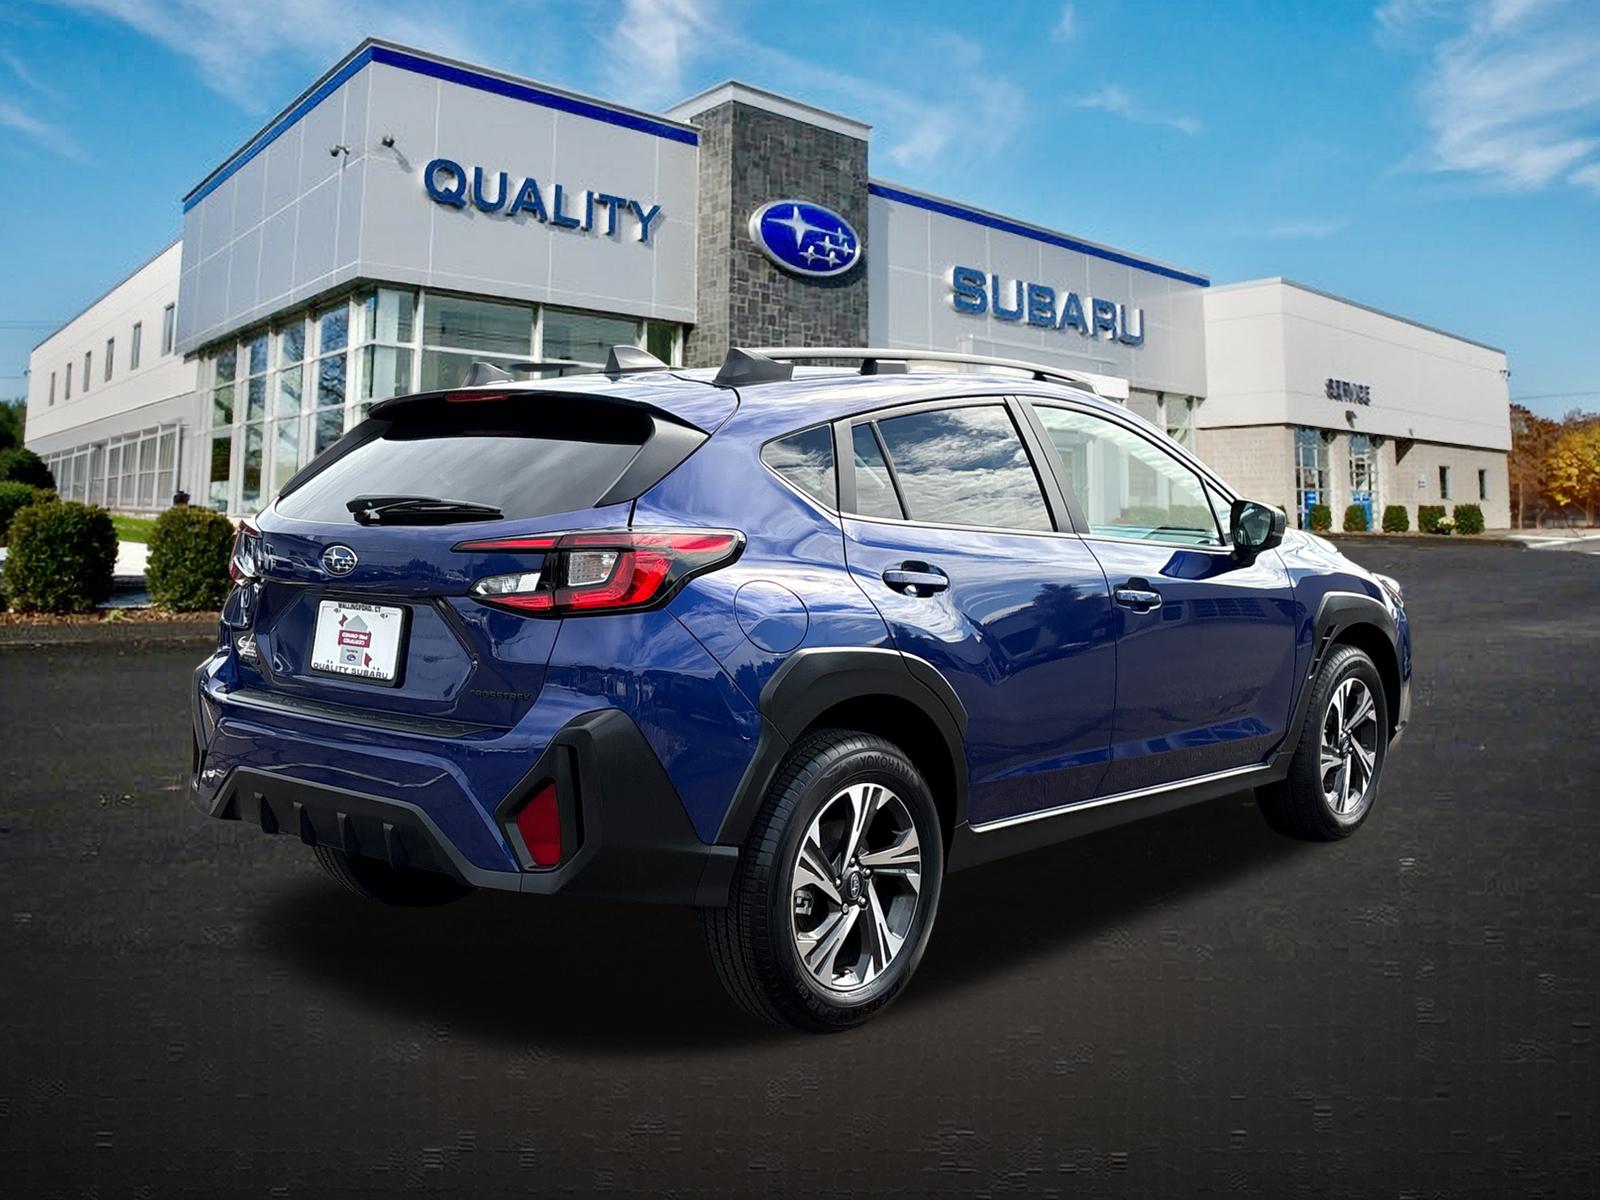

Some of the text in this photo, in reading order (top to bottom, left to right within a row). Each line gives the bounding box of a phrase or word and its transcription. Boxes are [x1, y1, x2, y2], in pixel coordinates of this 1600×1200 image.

[424, 157, 661, 242] QUALITY
[951, 265, 1145, 347] SUBARU
[1325, 377, 1370, 406] SERVICE
[313, 662, 388, 679] QUALITY SUBARU
